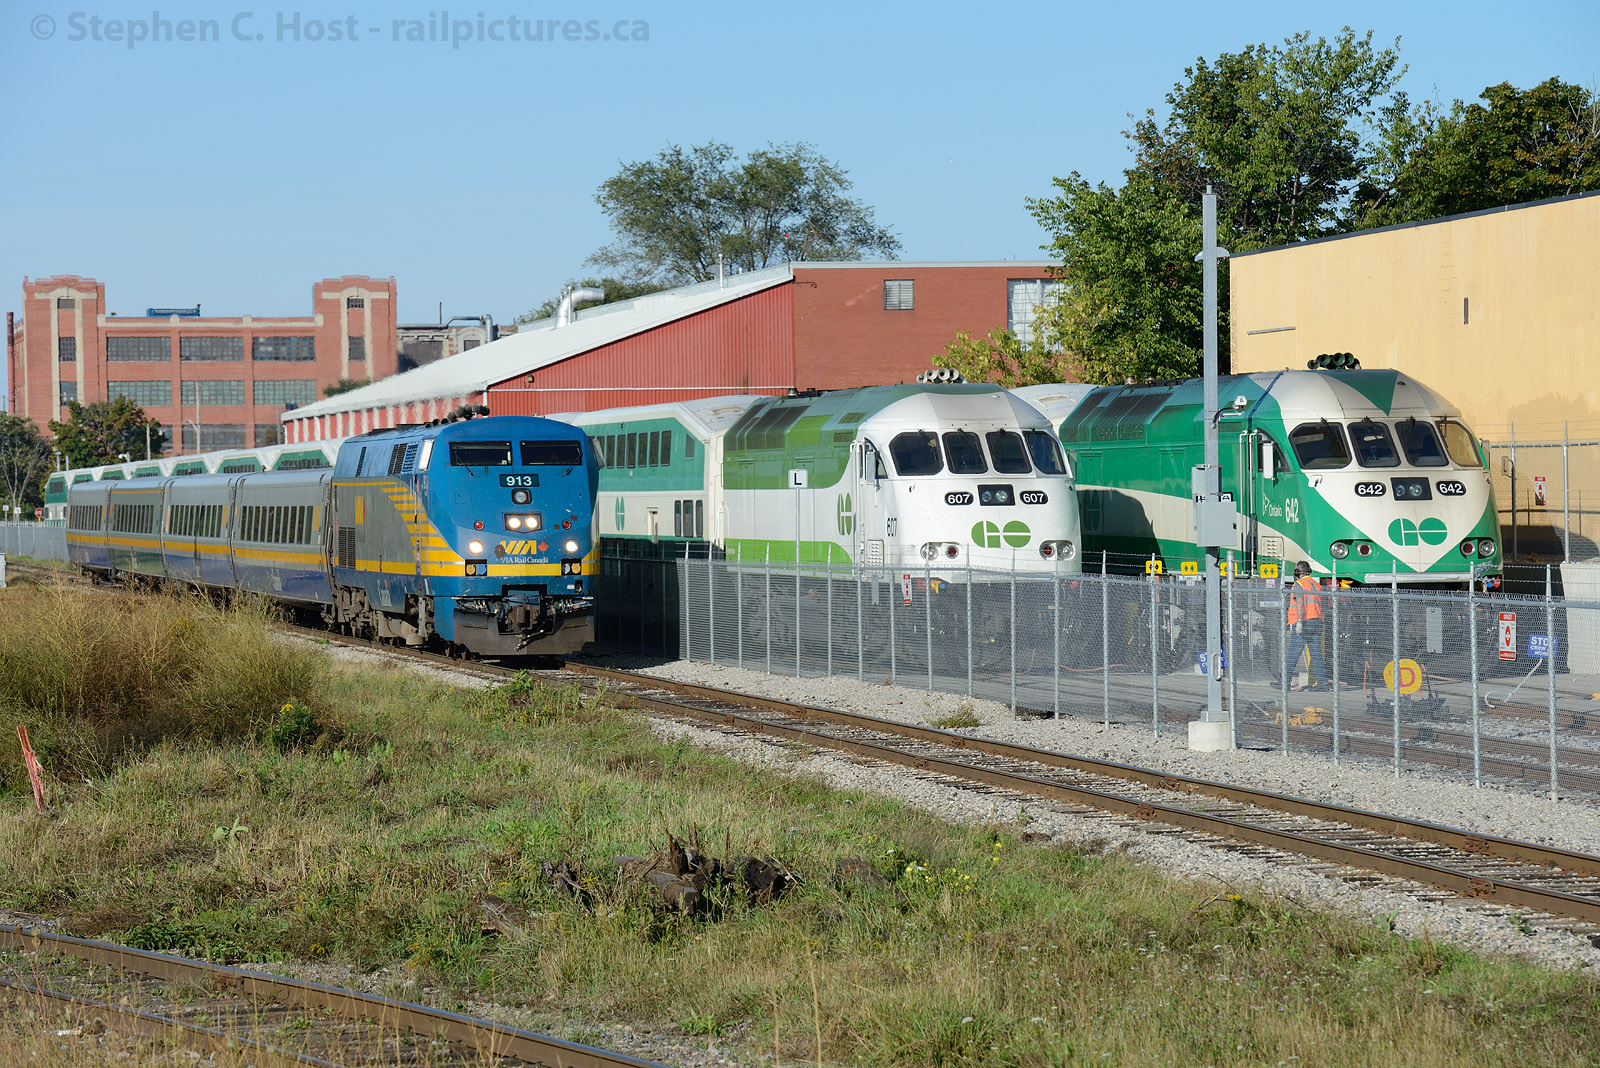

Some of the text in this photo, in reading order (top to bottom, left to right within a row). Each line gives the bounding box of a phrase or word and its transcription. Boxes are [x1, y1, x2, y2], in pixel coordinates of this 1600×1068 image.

[506, 476, 532, 486] 913
[794, 473, 802, 486] L
[1357, 484, 1383, 495] 642
[1439, 483, 1464, 494] 642
[947, 494, 971, 505] 607
[1023, 493, 1044, 503] 607
[1285, 497, 1299, 523] 642
[886, 517, 897, 537] 607
[499, 540, 537, 555] VIA
[514, 556, 527, 564] Rail
[527, 556, 549, 564] Canada
